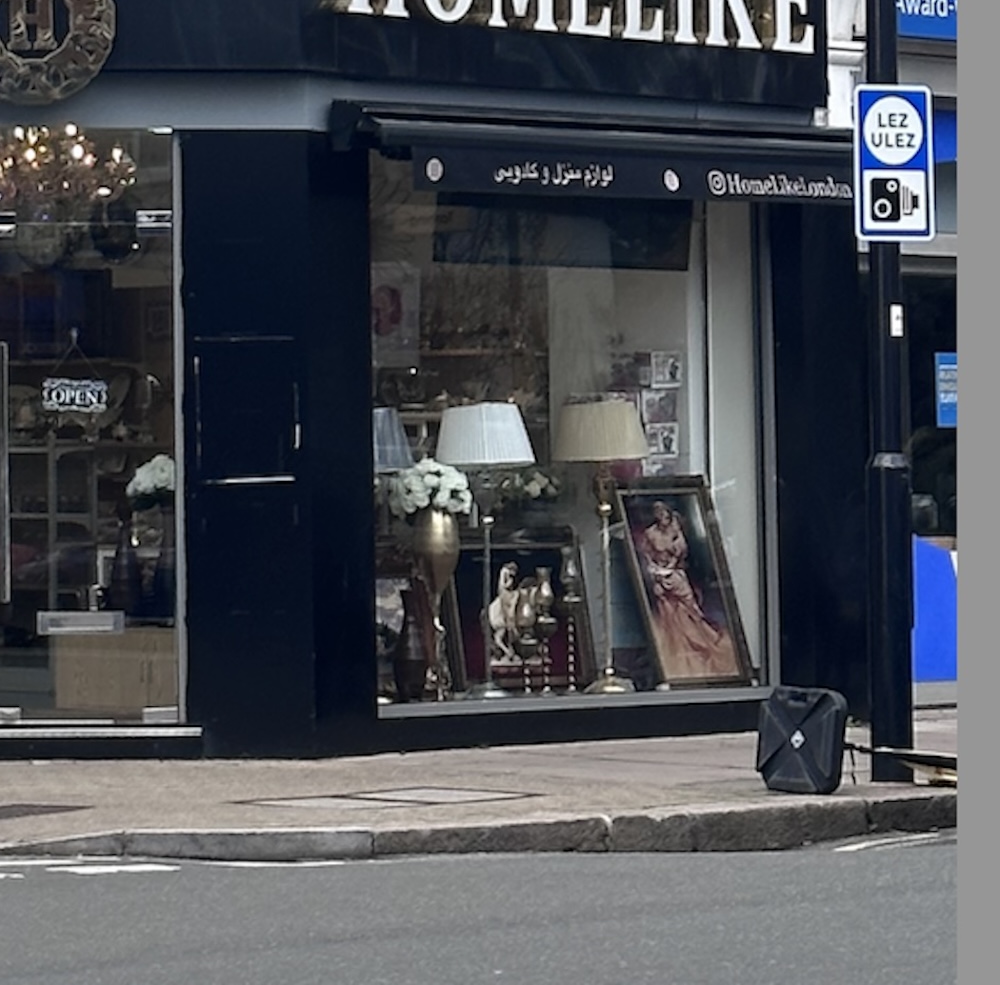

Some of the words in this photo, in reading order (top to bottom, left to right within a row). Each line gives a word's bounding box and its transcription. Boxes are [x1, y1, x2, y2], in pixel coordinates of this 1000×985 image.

[878, 113, 908, 128] LEZ
[871, 132, 916, 148] ULEZ
[51, 389, 99, 405] OPEN
